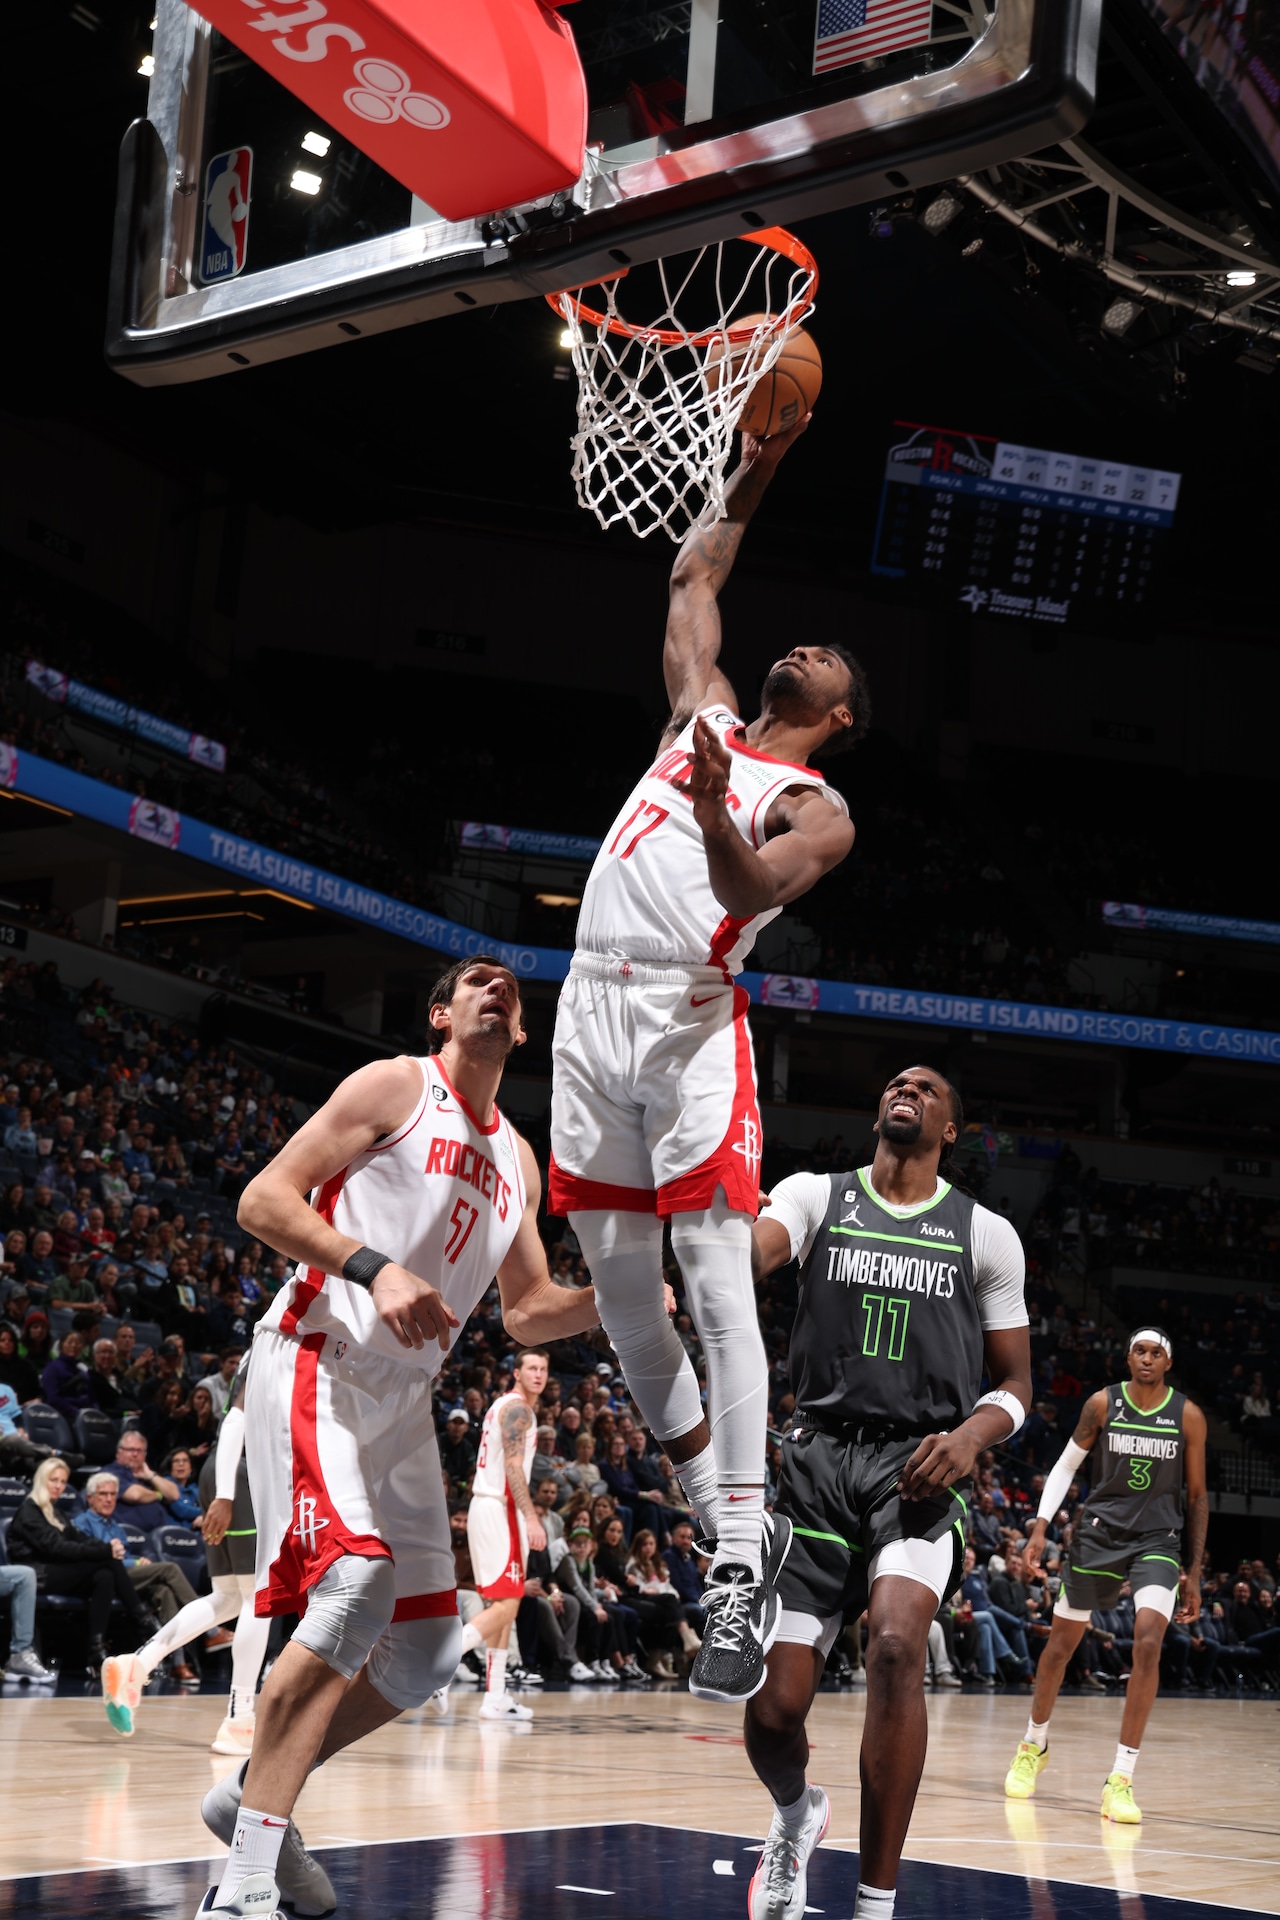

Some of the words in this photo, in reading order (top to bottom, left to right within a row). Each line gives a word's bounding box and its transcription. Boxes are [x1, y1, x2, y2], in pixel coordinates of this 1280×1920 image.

[206, 250, 228, 275] NBA
[999, 467, 1015, 478] 45
[1026, 471, 1041, 483] 41
[1055, 475, 1068, 487] 71
[1102, 484, 1117, 496] 25
[1131, 489, 1145, 501] 22
[1160, 494, 1168, 504] 7
[1078, 533, 1088, 544] 4
[740, 764, 767, 787] karma
[750, 762, 775, 781] credit
[608, 799, 670, 860] 17
[210, 832, 314, 894] TREASURE
[316, 875, 383, 920] ISLAND
[384, 903, 447, 942] RESORT
[449, 928, 462, 952] &
[465, 934, 538, 972] CASINO
[855, 989, 984, 1024] TREASURE
[989, 1005, 1079, 1033] ISLAND
[1081, 1015, 1170, 1044] RESORT
[1175, 1026, 1193, 1047] &
[425, 1137, 512, 1223] ROCKETS
[844, 1190, 857, 1203] 6
[444, 1197, 479, 1265] 51
[827, 1247, 958, 1300] TIMBERWOLVES
[862, 1294, 910, 1361] 11
[1115, 1399, 1122, 1407] 6
[1108, 1432, 1179, 1461] TIMBERWOLVES
[1127, 1458, 1153, 1491] 3
